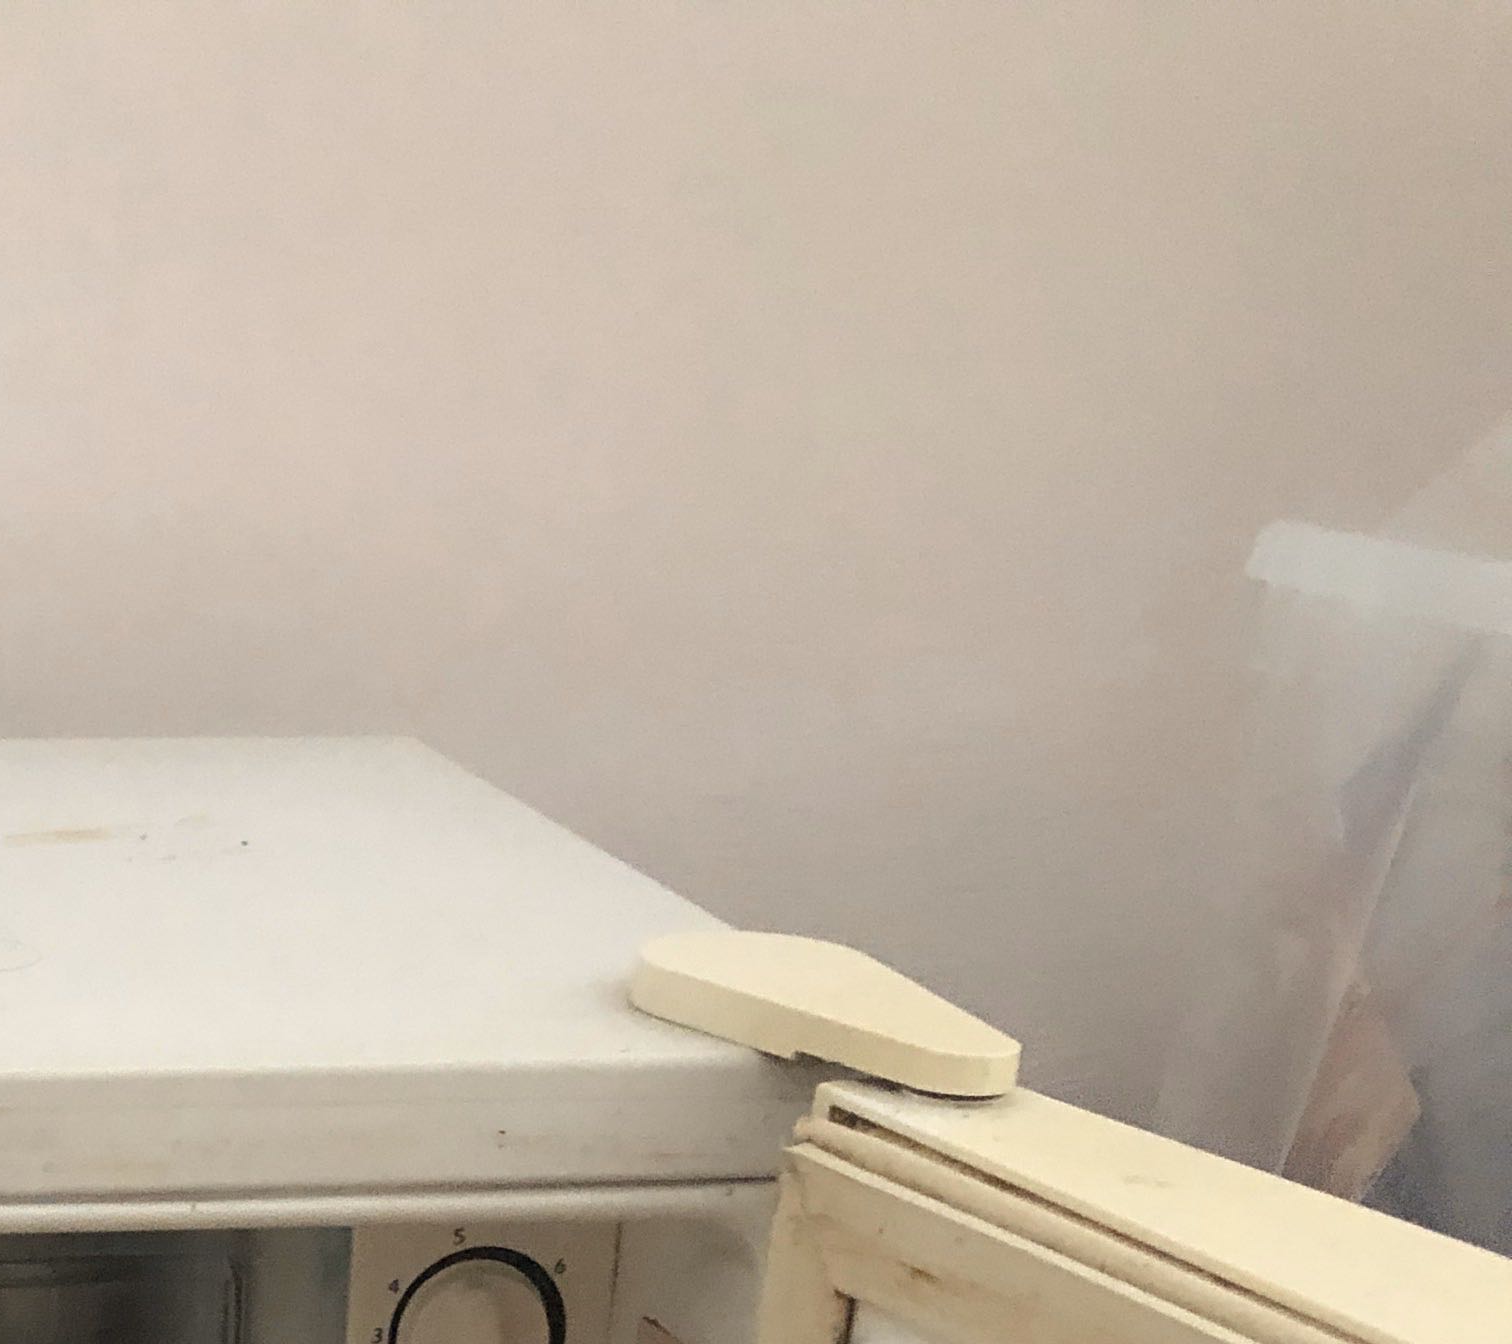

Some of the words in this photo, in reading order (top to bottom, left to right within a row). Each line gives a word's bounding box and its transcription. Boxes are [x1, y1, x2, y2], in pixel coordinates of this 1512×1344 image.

[452, 1227, 466, 1245] 5
[554, 1257, 567, 1275] 6
[387, 1279, 400, 1295] 4
[370, 1327, 384, 1344] 3
